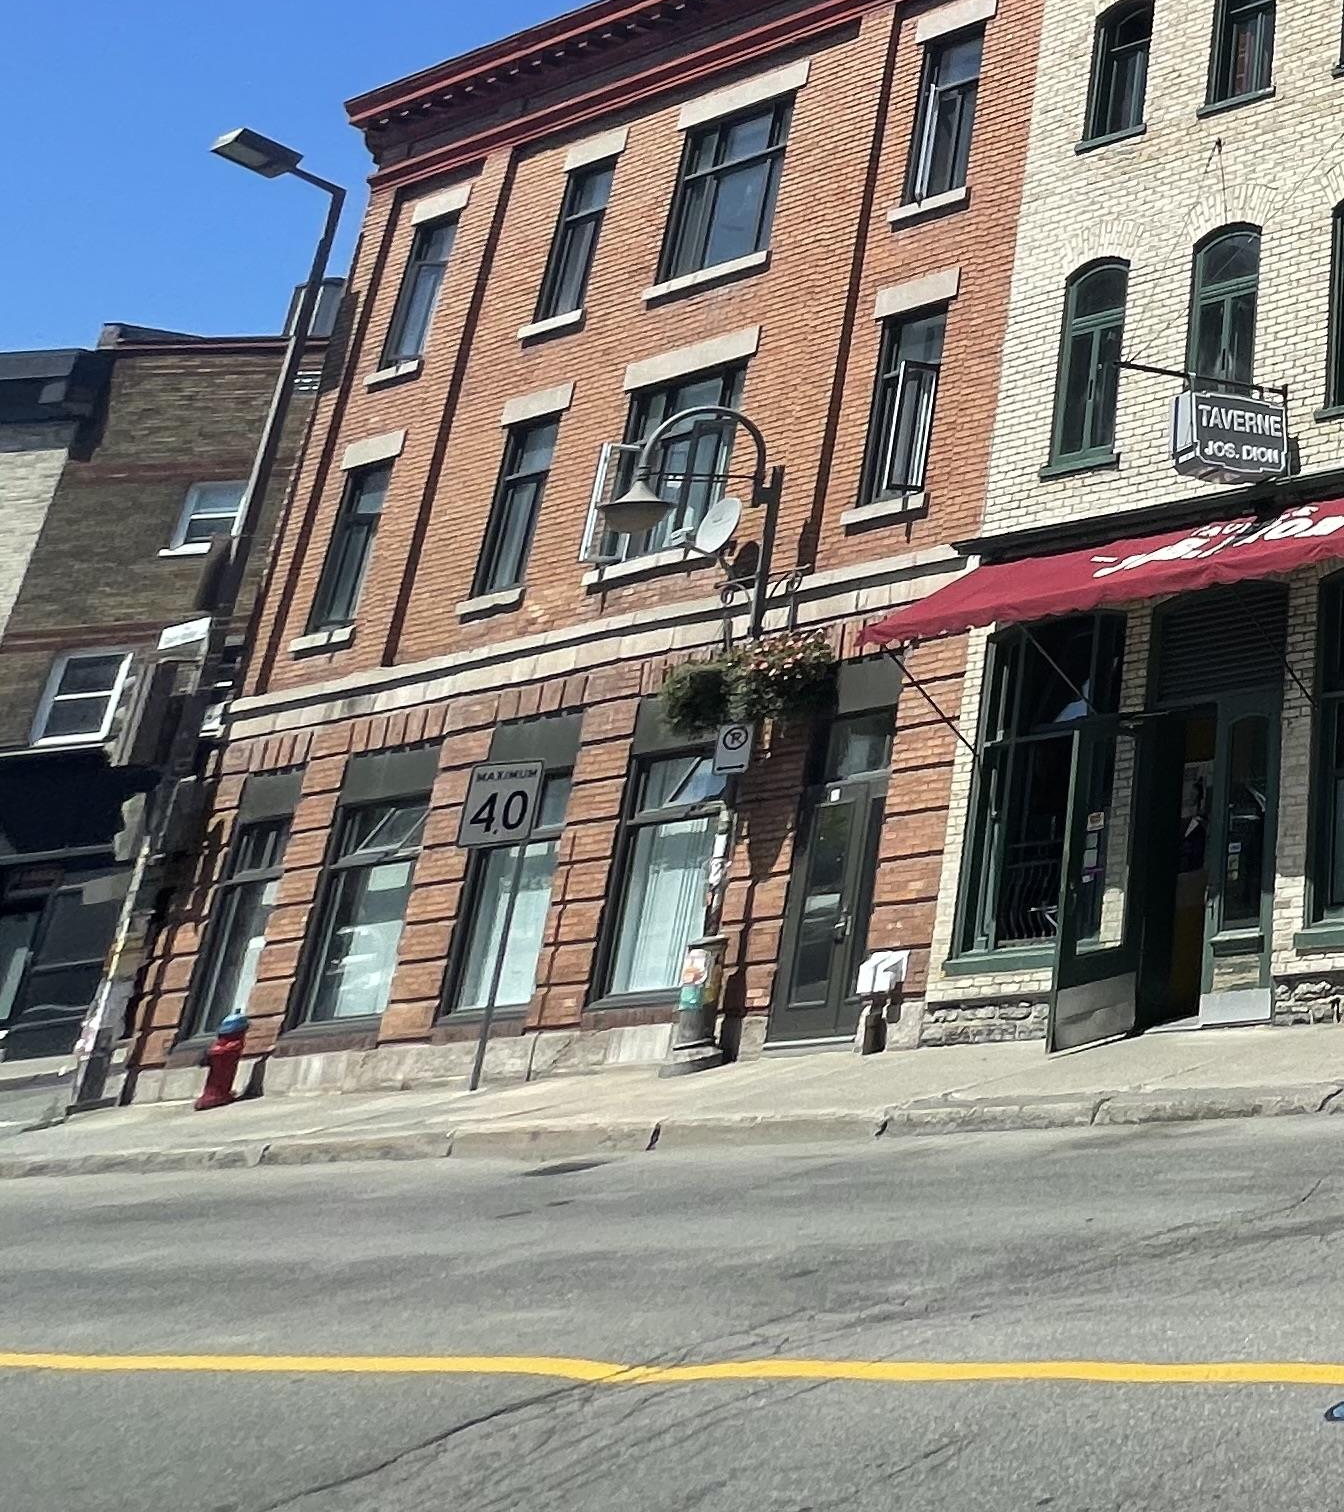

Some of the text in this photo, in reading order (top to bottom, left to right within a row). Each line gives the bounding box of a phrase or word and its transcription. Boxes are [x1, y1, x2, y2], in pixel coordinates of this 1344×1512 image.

[1198, 404, 1282, 438] TAVERNE
[1204, 440, 1279, 464] JOS. DION
[476, 769, 538, 782] MAXIMUM
[469, 790, 529, 833] 40
